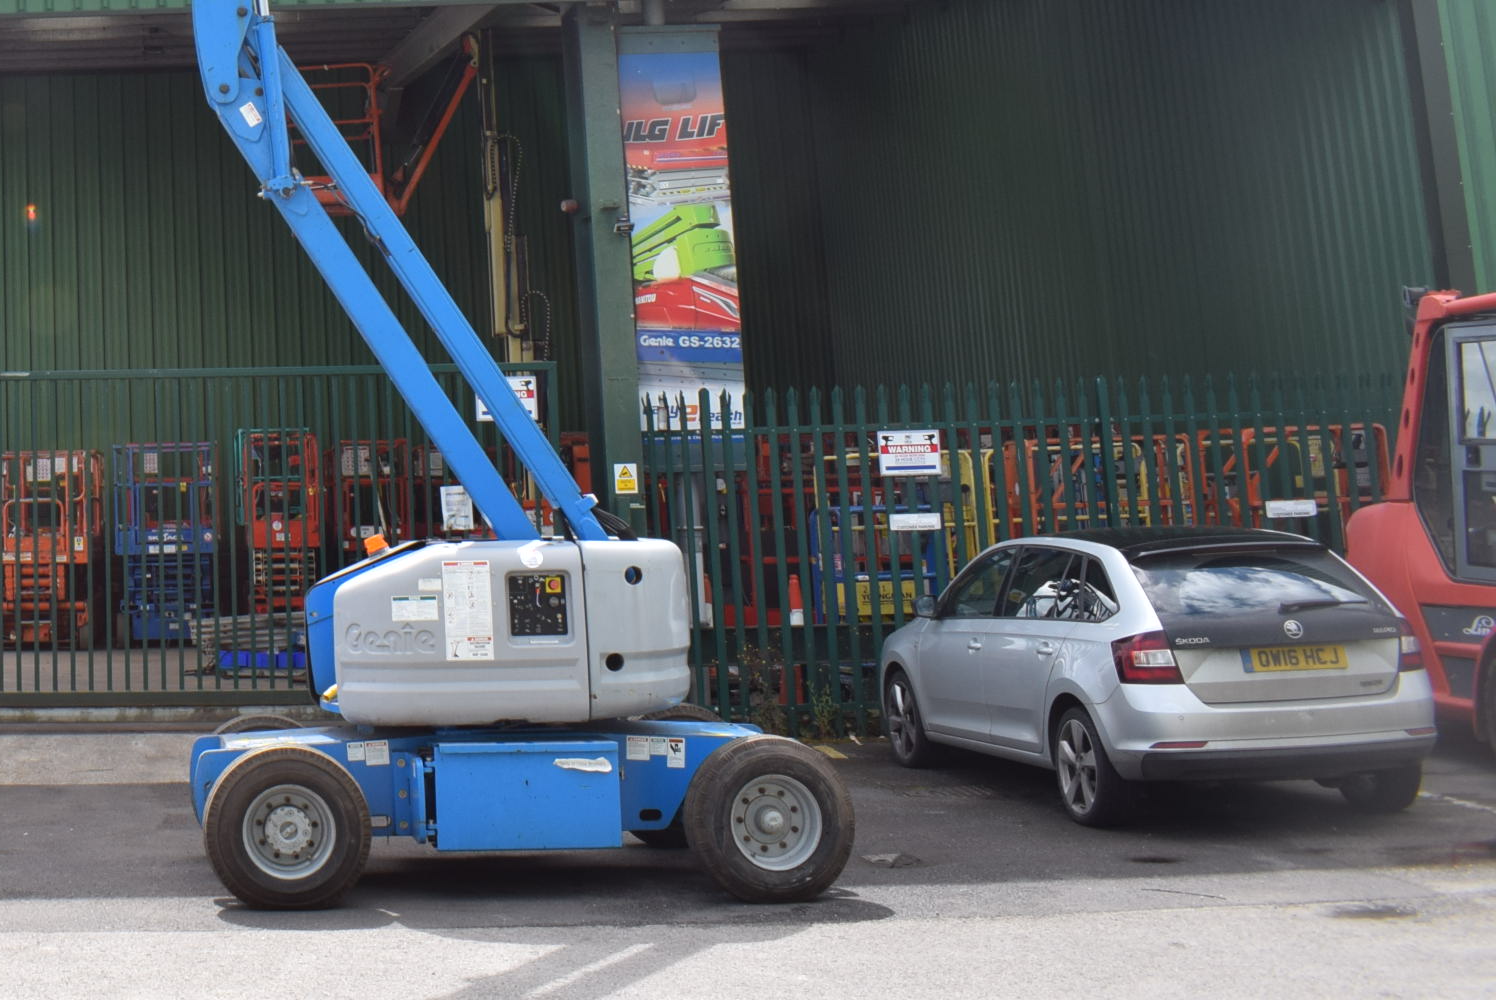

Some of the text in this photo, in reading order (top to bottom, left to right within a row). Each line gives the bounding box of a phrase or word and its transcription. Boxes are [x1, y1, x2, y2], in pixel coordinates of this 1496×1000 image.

[640, 335, 740, 348] Genie GS-2632
[888, 445, 931, 454] WARNING
[345, 622, 436, 655] Genie
[1304, 647, 1340, 666] HCJ
